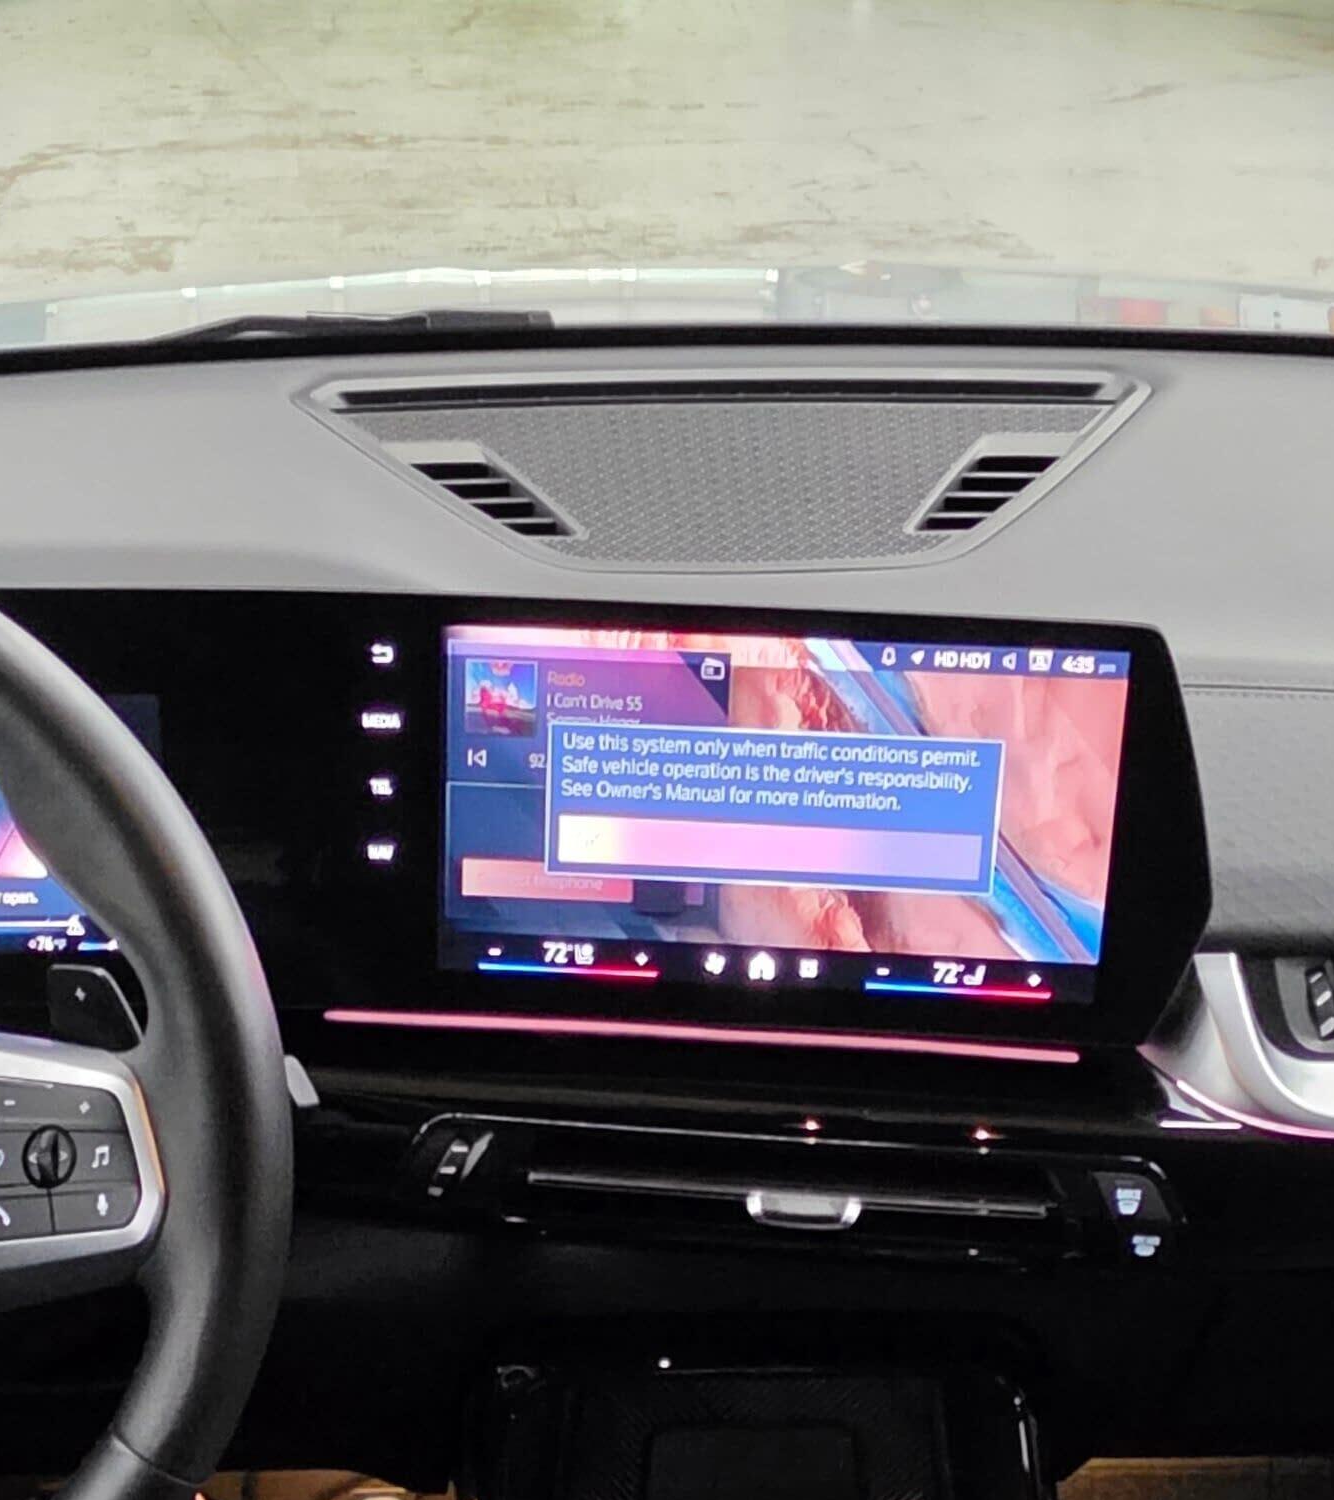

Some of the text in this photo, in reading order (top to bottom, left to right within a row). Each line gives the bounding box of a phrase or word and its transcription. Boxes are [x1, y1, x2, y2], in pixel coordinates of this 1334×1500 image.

[933, 651, 991, 670] HD HD1
[547, 671, 585, 688] Radio
[554, 692, 587, 709] Can't
[590, 694, 624, 711] Drive
[562, 732, 981, 769] Use this system only when traffic conditions permit.
[561, 755, 973, 794] Safe vehicle operation is the driver's responsibility.
[561, 779, 902, 811] See Owner's Manual for more information.
